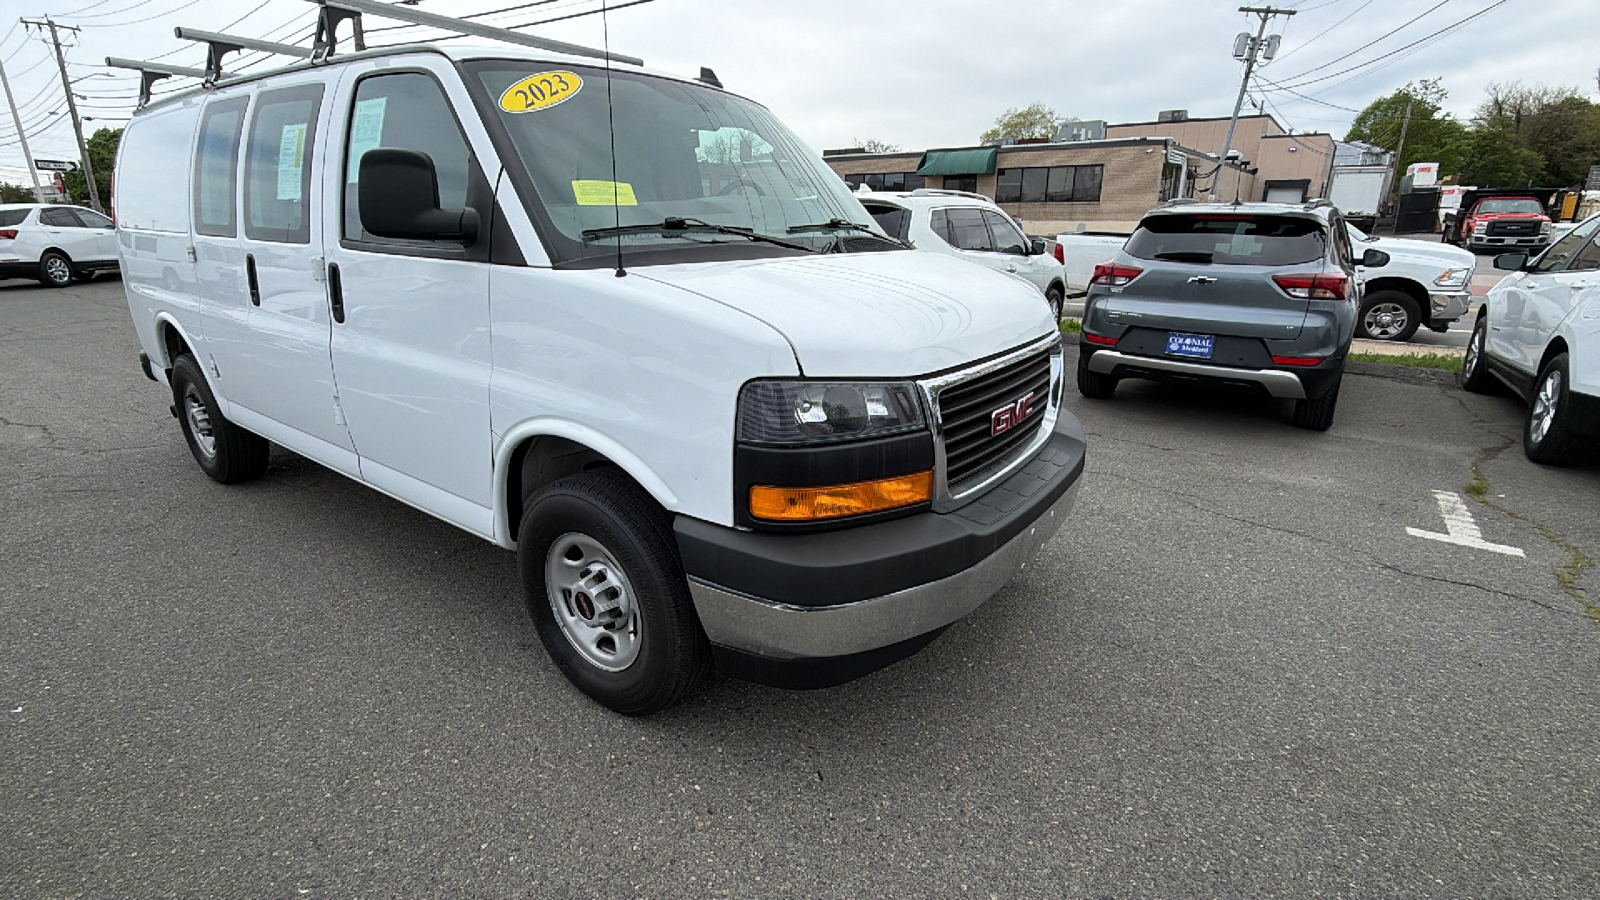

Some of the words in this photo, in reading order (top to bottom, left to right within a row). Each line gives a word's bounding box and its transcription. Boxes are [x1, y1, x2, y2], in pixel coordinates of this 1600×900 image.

[515, 74, 570, 109] 2023
[1169, 336, 1213, 347] COLONIAL
[1181, 344, 1210, 354] Medford
[991, 391, 1035, 437] GMC
